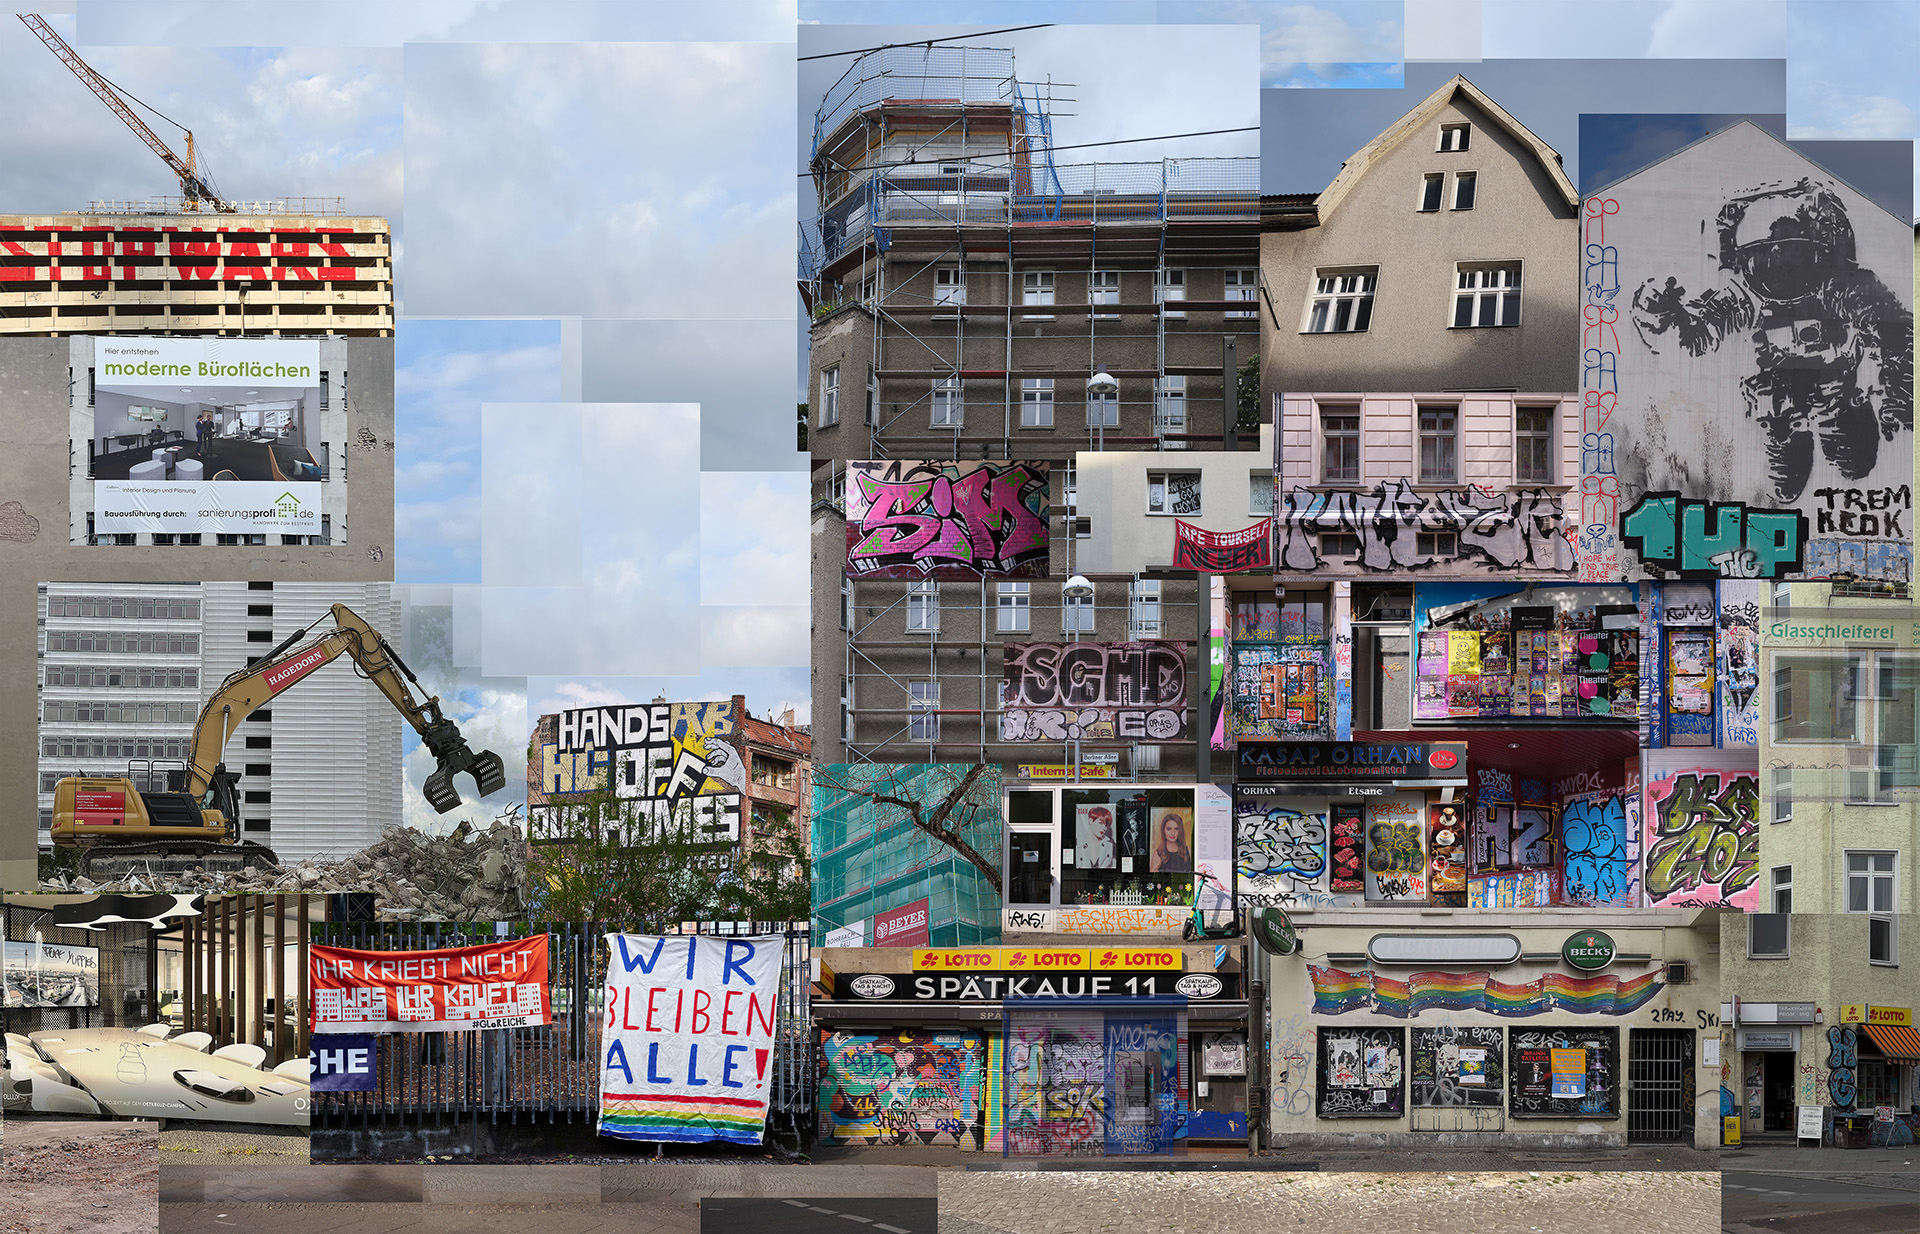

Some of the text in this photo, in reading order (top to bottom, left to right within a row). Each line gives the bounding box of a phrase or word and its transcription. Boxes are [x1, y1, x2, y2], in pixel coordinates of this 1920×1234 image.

[162, 226, 357, 281] WARS
[104, 347, 160, 356] Hier entstehen
[104, 360, 311, 378] moderne Büroflächen
[141, 486, 161, 495] Design
[162, 486, 173, 494] und
[104, 509, 187, 519] Bauausführung durch:
[1178, 519, 1270, 546] RAPE YOURSELF
[1622, 494, 1803, 578] 1UP
[1176, 536, 1268, 571] FUCKER!
[1583, 554, 1602, 562] HOPE
[1604, 554, 1617, 562] WE
[1580, 563, 1619, 571] FIND TRUE
[1587, 571, 1610, 579] PEACE
[1579, 631, 1610, 640] Theater
[1770, 622, 1895, 639] Glasschleiferei
[268, 651, 323, 686] HAGEDORN
[1578, 675, 1608, 684] Theater
[558, 703, 671, 751] HANDS
[1083, 753, 1104, 761] Berliner
[1241, 745, 1423, 765] KASAP ORHAN
[615, 747, 707, 800] OFF
[1080, 766, 1105, 776] Café
[1242, 787, 1276, 795] ORHAN
[1348, 786, 1383, 796] Etsane
[598, 793, 741, 848] HOMES
[888, 909, 926, 931] BEYER
[1570, 946, 1611, 956] BECK'S
[315, 949, 533, 981] IHR KRIEGT NICHT
[617, 934, 758, 986] WIR
[945, 953, 992, 967] LOTTO
[1033, 952, 1082, 966] LOTTO
[1124, 952, 1174, 966] LOTTO
[914, 975, 1156, 999] SPÄTKAUF 11
[341, 986, 388, 1010] WAS
[396, 984, 435, 1010] IHR
[1880, 1010, 1905, 1022] LOTTO
[606, 1037, 770, 1089] ALLE!
